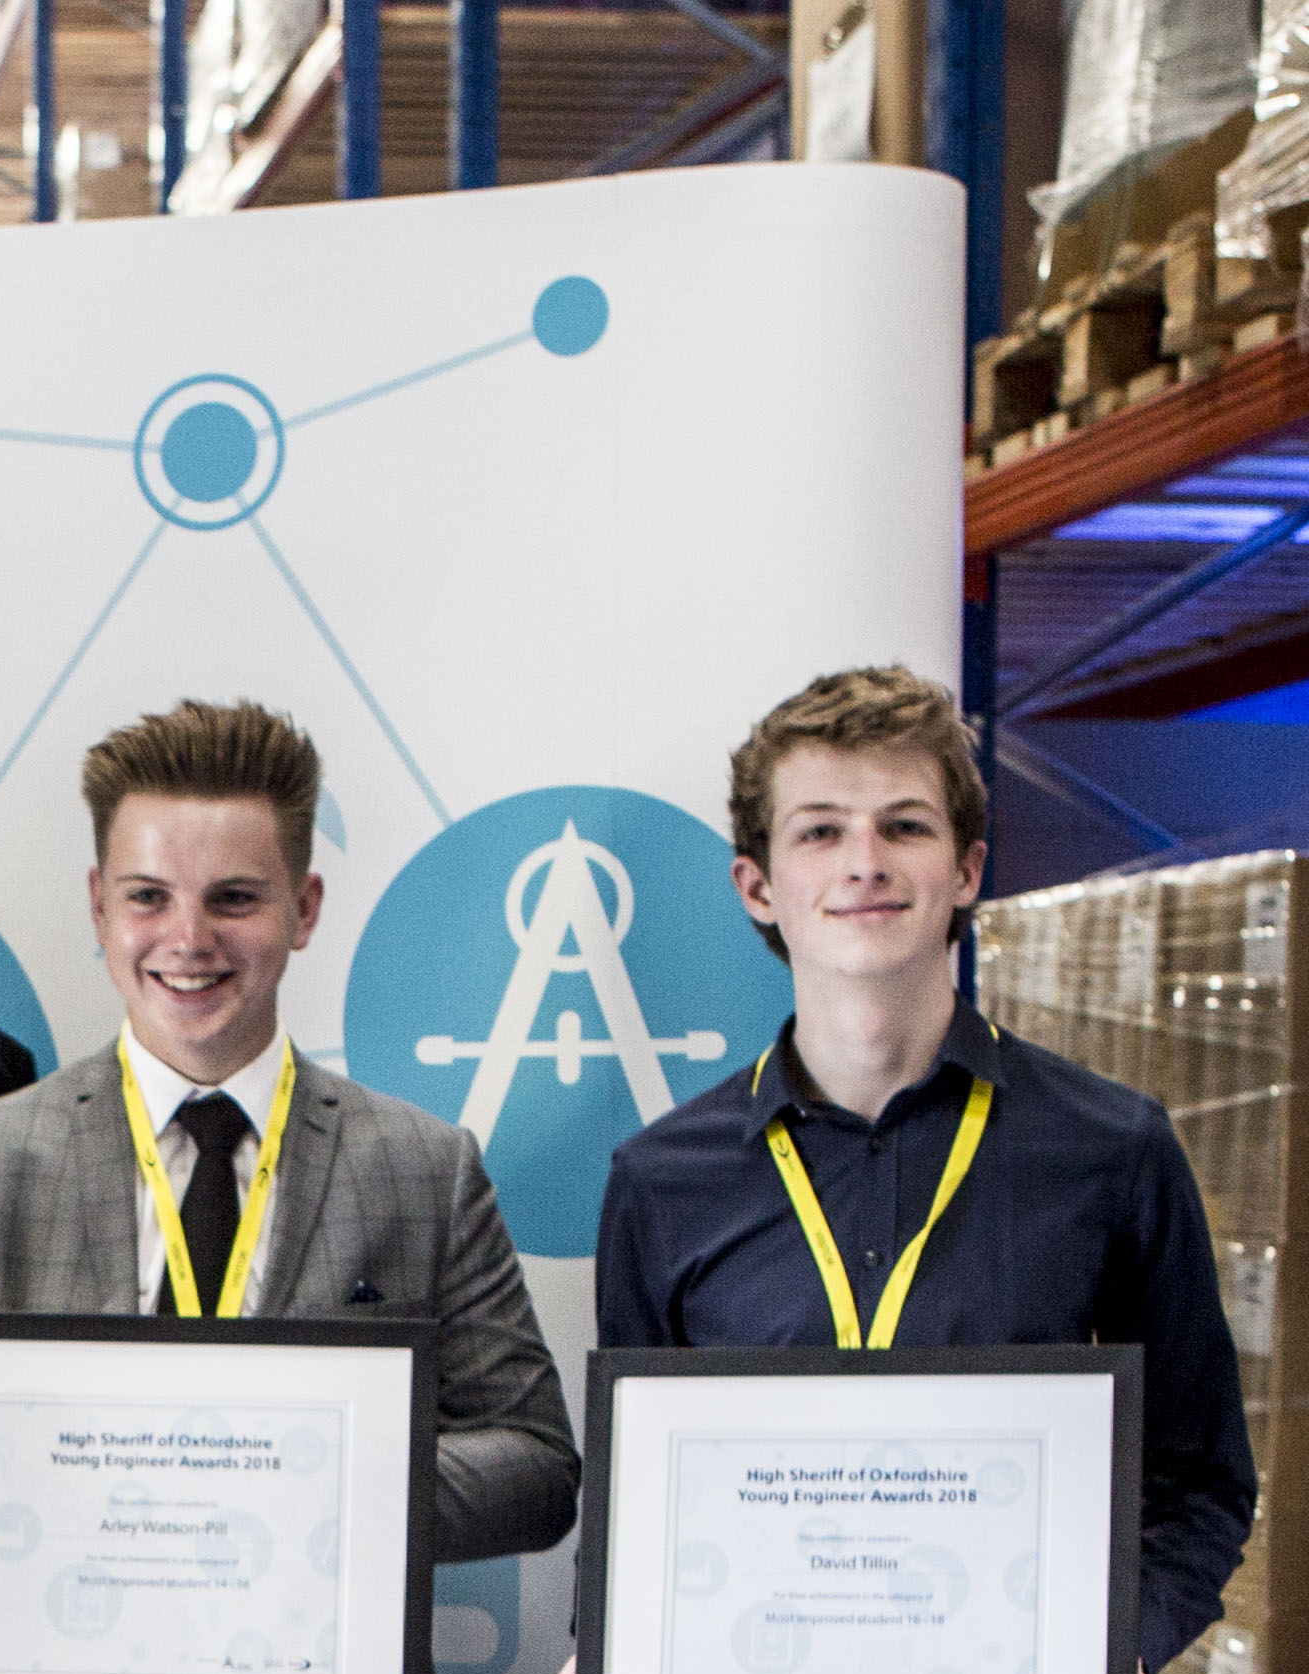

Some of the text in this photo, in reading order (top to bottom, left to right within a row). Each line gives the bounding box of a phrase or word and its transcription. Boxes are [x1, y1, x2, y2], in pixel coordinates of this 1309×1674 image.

[59, 1432, 273, 1450] High Sheriff of Oxfordshire
[52, 1453, 281, 1470] Young Engineer Awards 2018
[747, 1468, 968, 1484] High Sheriff of Oxfordshire
[738, 1489, 977, 1505] Young Engineer Awards 2018
[100, 1520, 227, 1536] Arley Watson-Pill
[811, 1555, 897, 1570] David Tillin
[765, 1613, 794, 1624] Most
[797, 1613, 854, 1626] improved
[858, 1613, 903, 1624] student
[907, 1614, 921, 1624] 16
[931, 1614, 945, 1624] 18
